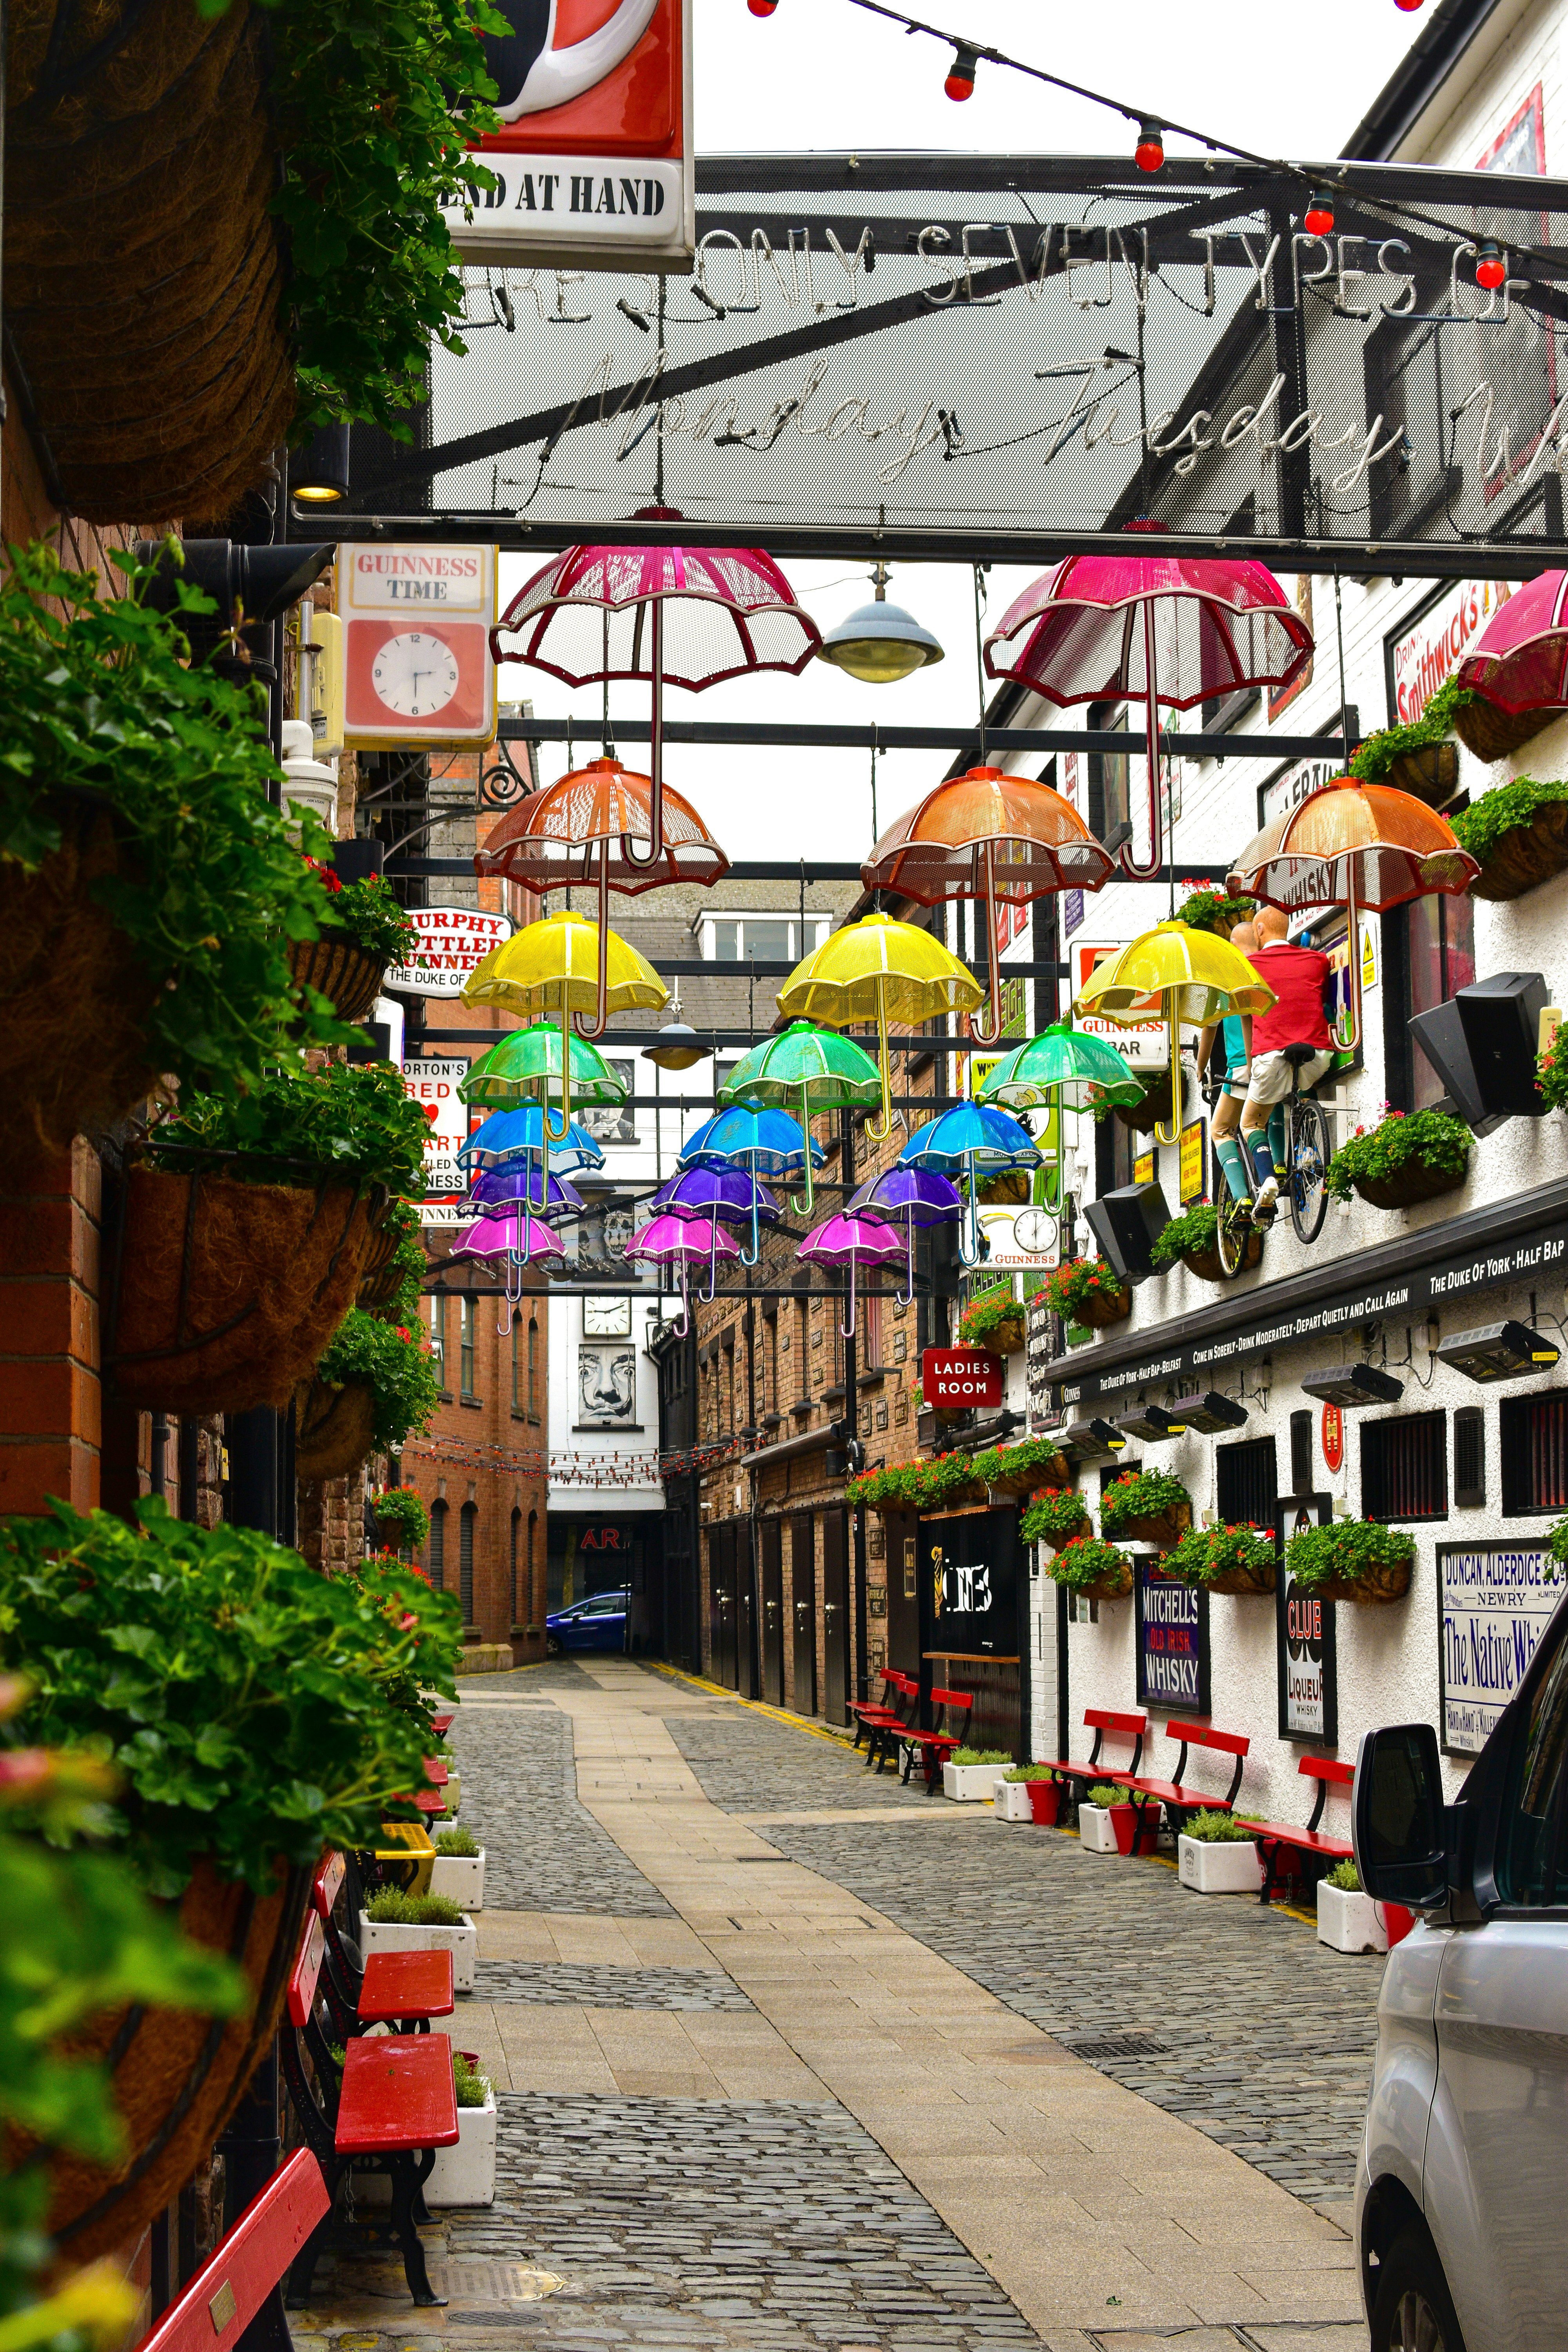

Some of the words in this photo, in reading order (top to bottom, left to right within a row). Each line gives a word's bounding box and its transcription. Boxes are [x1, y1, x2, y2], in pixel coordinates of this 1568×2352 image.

[515, 174, 559, 211] AT
[570, 176, 664, 216] HAND
[699, 227, 871, 310] ONLY
[918, 225, 1149, 307] SEVEN
[1190, 229, 1417, 317] TYPES
[540, 347, 956, 485] Monday
[1035, 357, 1407, 495] Tuesday
[358, 554, 477, 577] GUINNESS
[387, 579, 447, 600] TIME
[410, 634, 421, 643] 12
[375, 668, 382, 678] 9
[449, 671, 456, 681] 3
[411, 706, 418, 715] 6
[410, 913, 503, 935] URPHY
[407, 935, 504, 953] TTLED
[389, 969, 411, 982] THE
[415, 972, 446, 985] DUKE
[450, 974, 465, 986] OF
[1107, 1041, 1141, 1055] BAR
[403, 1063, 464, 1076] ORTON'S
[404, 1082, 450, 1098] RED
[423, 1135, 466, 1151] ART
[423, 1159, 451, 1169] TLED
[426, 1174, 463, 1188] NESS
[995, 1254, 1055, 1263] GUINNESS
[1430, 1276, 1446, 1294] THE
[1447, 1269, 1471, 1290] DUKE
[1472, 1263, 1485, 1281] OF
[1487, 1257, 1511, 1277] YORK
[1516, 1246, 1542, 1269] HALF
[1544, 1240, 1564, 1261] BAP
[1193, 1351, 1207, 1365] COME
[1208, 1348, 1213, 1361] IN
[1214, 1341, 1236, 1359] SOBERLY
[1238, 1335, 1255, 1352] DRINK
[1256, 1323, 1293, 1347] MODERATELY
[1296, 1314, 1321, 1334] DEPART
[1322, 1306, 1349, 1327] QUIETLY
[1349, 1302, 1364, 1319] AND
[1365, 1296, 1384, 1314] CALL
[1385, 1288, 1409, 1308] AGAIN
[935, 1363, 990, 1374] LADIES
[1108, 1376, 1119, 1388] DUKE
[1119, 1373, 1125, 1386] OF
[1126, 1371, 1137, 1384] YORK
[1139, 1367, 1151, 1380] HALF
[1151, 1364, 1160, 1377] BAP
[1162, 1357, 1181, 1374] BELFAST
[939, 1382, 987, 1394] ROOM
[1064, 1386, 1080, 1403] GUINNESS
[581, 1528, 630, 1549] AR
[1445, 1552, 1485, 1588] DUNCAN,
[1486, 1550, 1541, 1586] ALDERDICE
[1143, 1586, 1198, 1624] MITCHELL'S
[1477, 1592, 1526, 1606] NEWRY
[1288, 1600, 1322, 1640] CLUB
[1150, 1627, 1164, 1650] OLD
[1167, 1628, 1190, 1652] IRISH
[1443, 1617, 1468, 1686] The
[1469, 1618, 1514, 1690] Native
[1145, 1653, 1199, 1694] WHISKY
[1296, 1704, 1318, 1716] WHISKY
